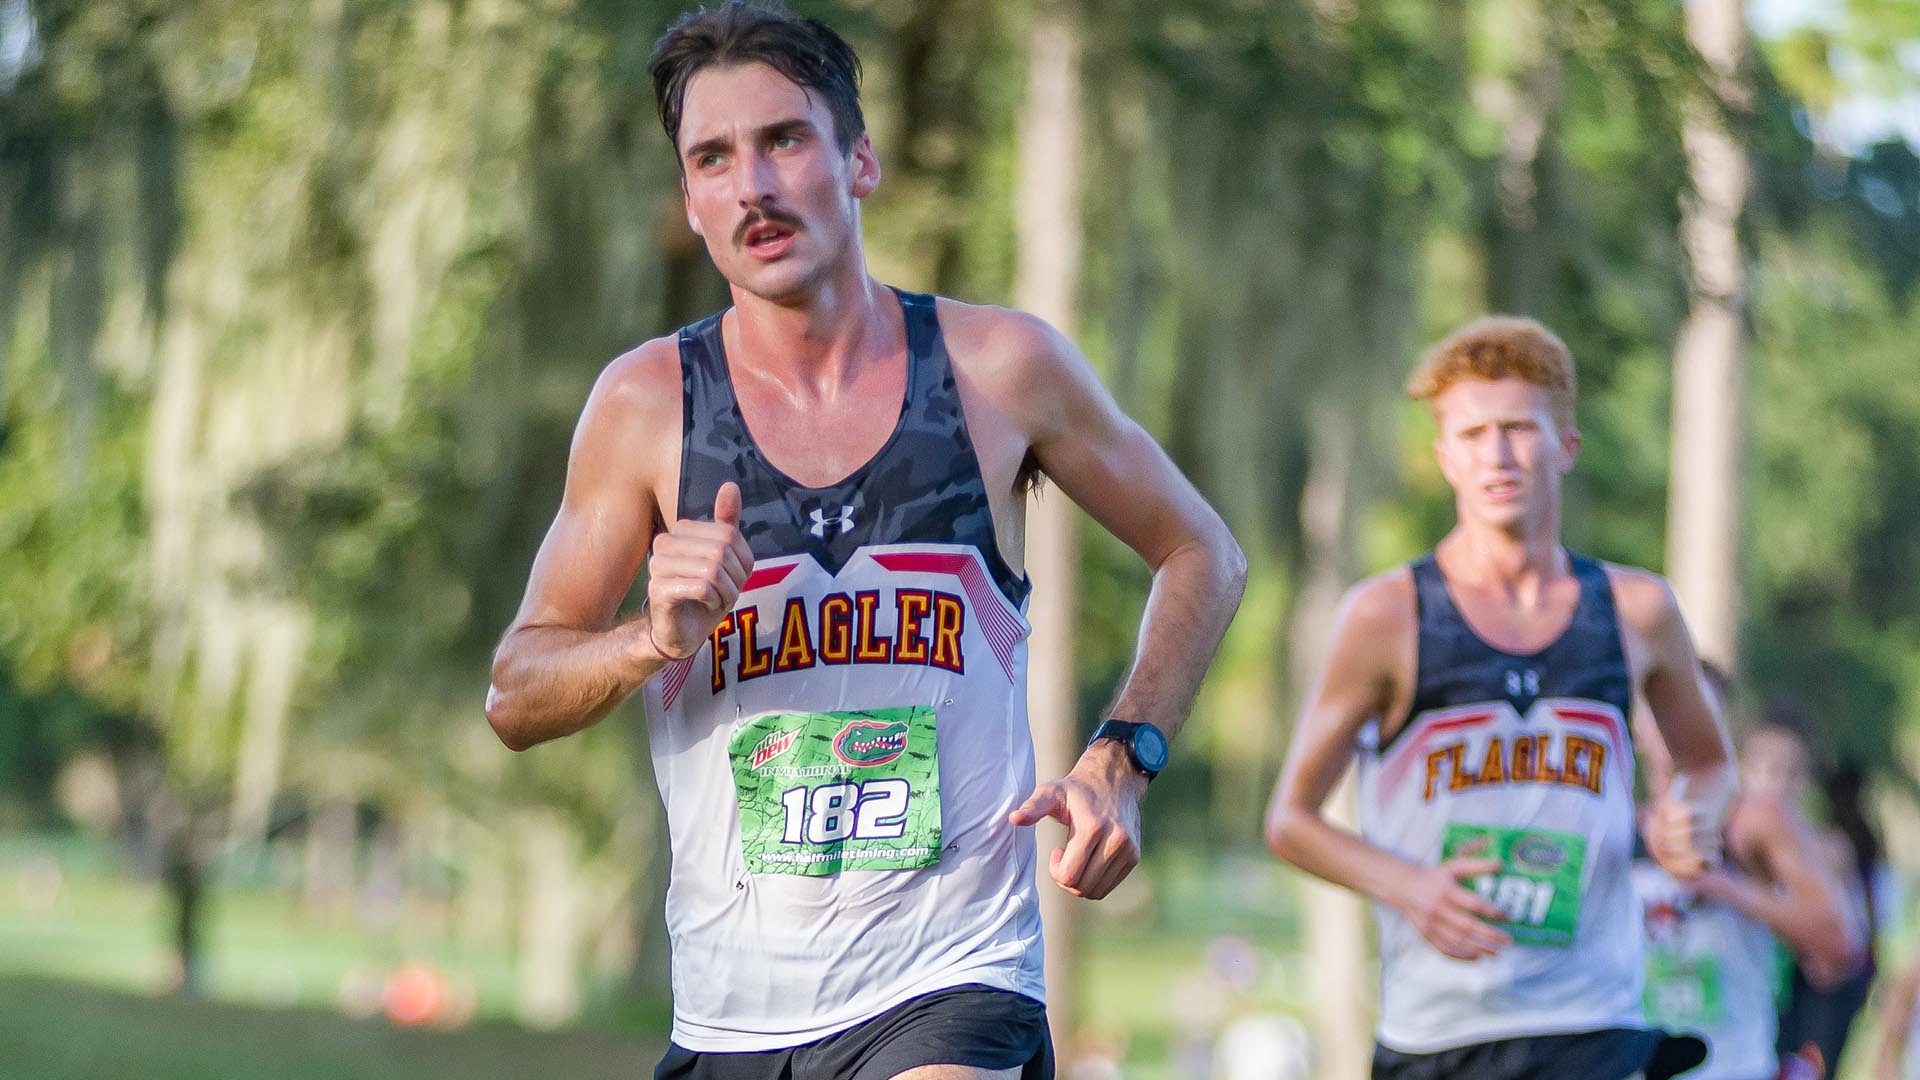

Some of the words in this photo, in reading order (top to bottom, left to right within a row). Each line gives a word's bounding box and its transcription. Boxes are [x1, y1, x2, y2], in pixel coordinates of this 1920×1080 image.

[711, 588, 966, 695] FLAGLER
[1423, 733, 1607, 803] FLAGLER
[780, 778, 910, 845] 182
[761, 847, 929, 864] www.halfmiletiming.com
